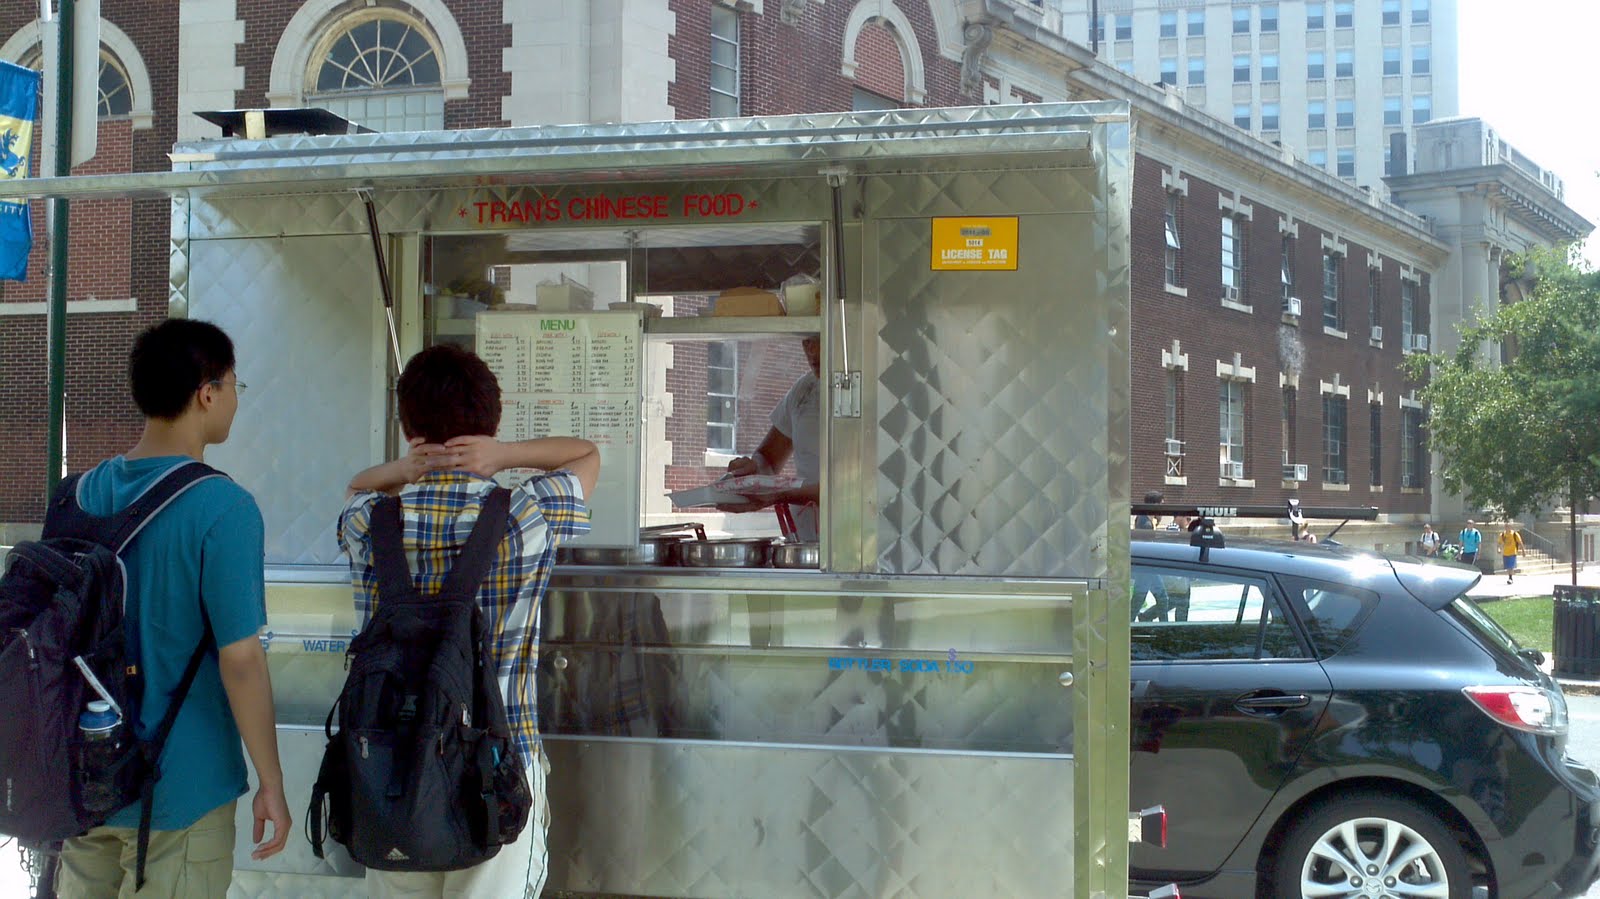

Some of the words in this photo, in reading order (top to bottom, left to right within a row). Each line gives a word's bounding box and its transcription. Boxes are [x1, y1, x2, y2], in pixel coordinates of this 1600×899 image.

[473, 193, 562, 224] TRAN'S
[567, 193, 668, 220] CHINESE
[683, 193, 744, 217] FOOD
[941, 249, 983, 260] LICENSE
[988, 249, 1008, 260] TAG
[540, 319, 576, 331] MENU
[1197, 507, 1237, 517] THULE
[303, 640, 346, 652] WATER
[899, 659, 940, 673] SODA
